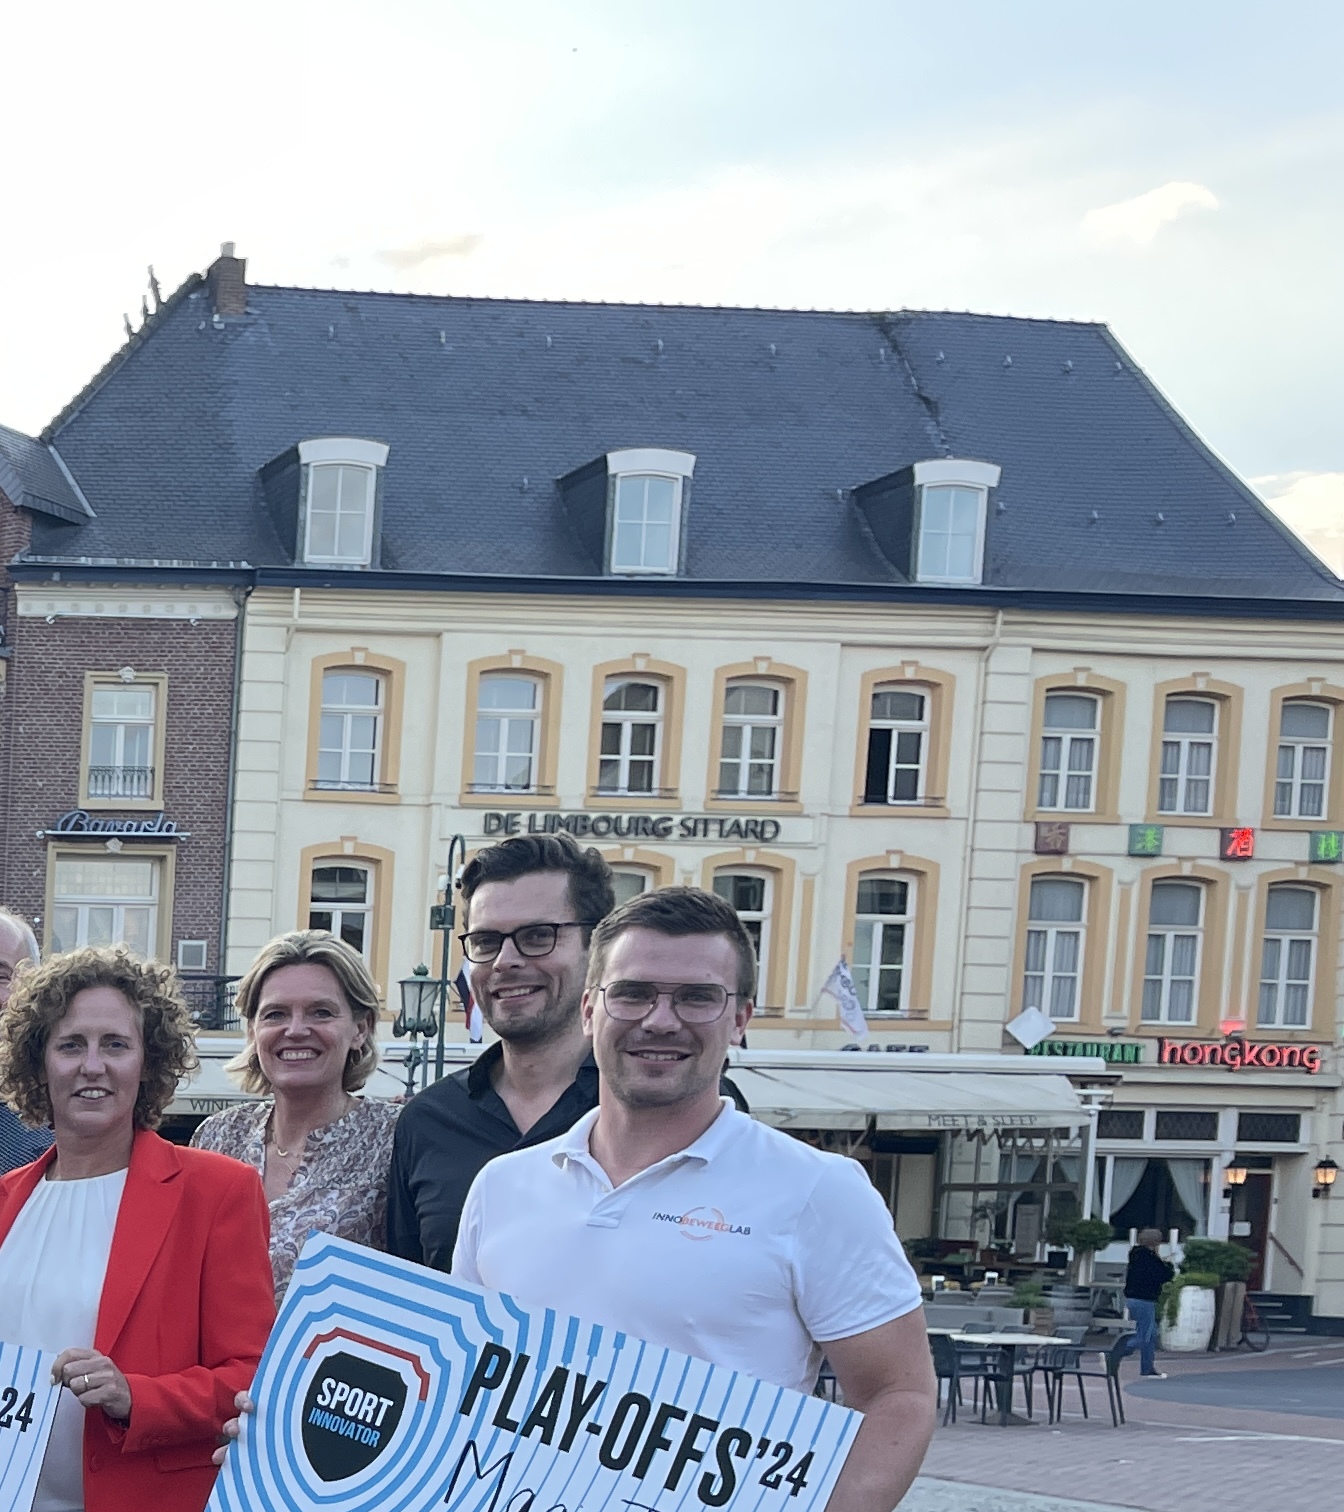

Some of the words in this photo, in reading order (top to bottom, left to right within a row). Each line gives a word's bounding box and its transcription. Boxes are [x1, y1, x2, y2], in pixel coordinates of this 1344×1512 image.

[56, 809, 178, 833] Bavaria
[483, 811, 522, 835] DE
[528, 812, 674, 839] LIMBOURG
[678, 815, 782, 843] SITTARD
[1161, 1037, 1321, 1073] hongkong
[927, 1114, 970, 1127] MEET
[316, 1377, 394, 1429] SPORT
[308, 1406, 381, 1449] INNOVATOR
